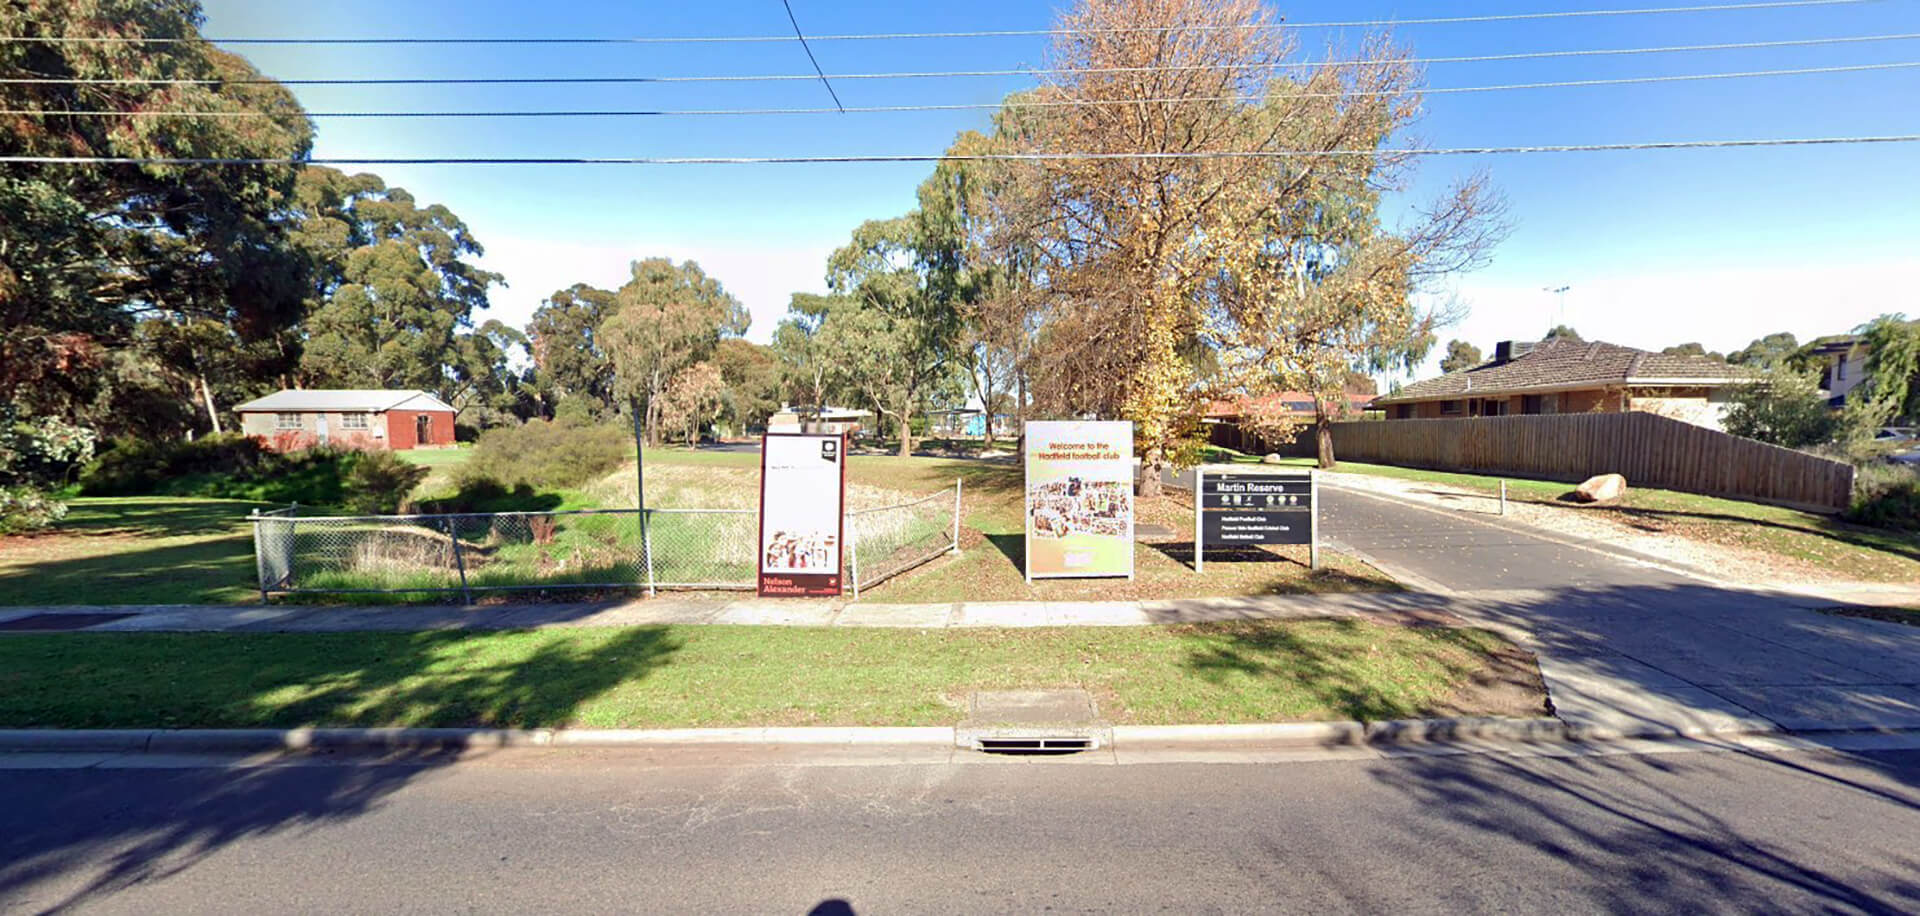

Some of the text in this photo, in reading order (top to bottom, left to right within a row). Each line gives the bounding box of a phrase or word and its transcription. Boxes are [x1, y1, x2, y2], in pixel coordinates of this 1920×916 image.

[1048, 442, 1109, 450] Welcome to the
[1038, 452, 1120, 460] Hadfield football club
[1216, 482, 1284, 493] Martin Reserve
[763, 577, 793, 585] Nelson
[763, 585, 806, 593] Alexander
